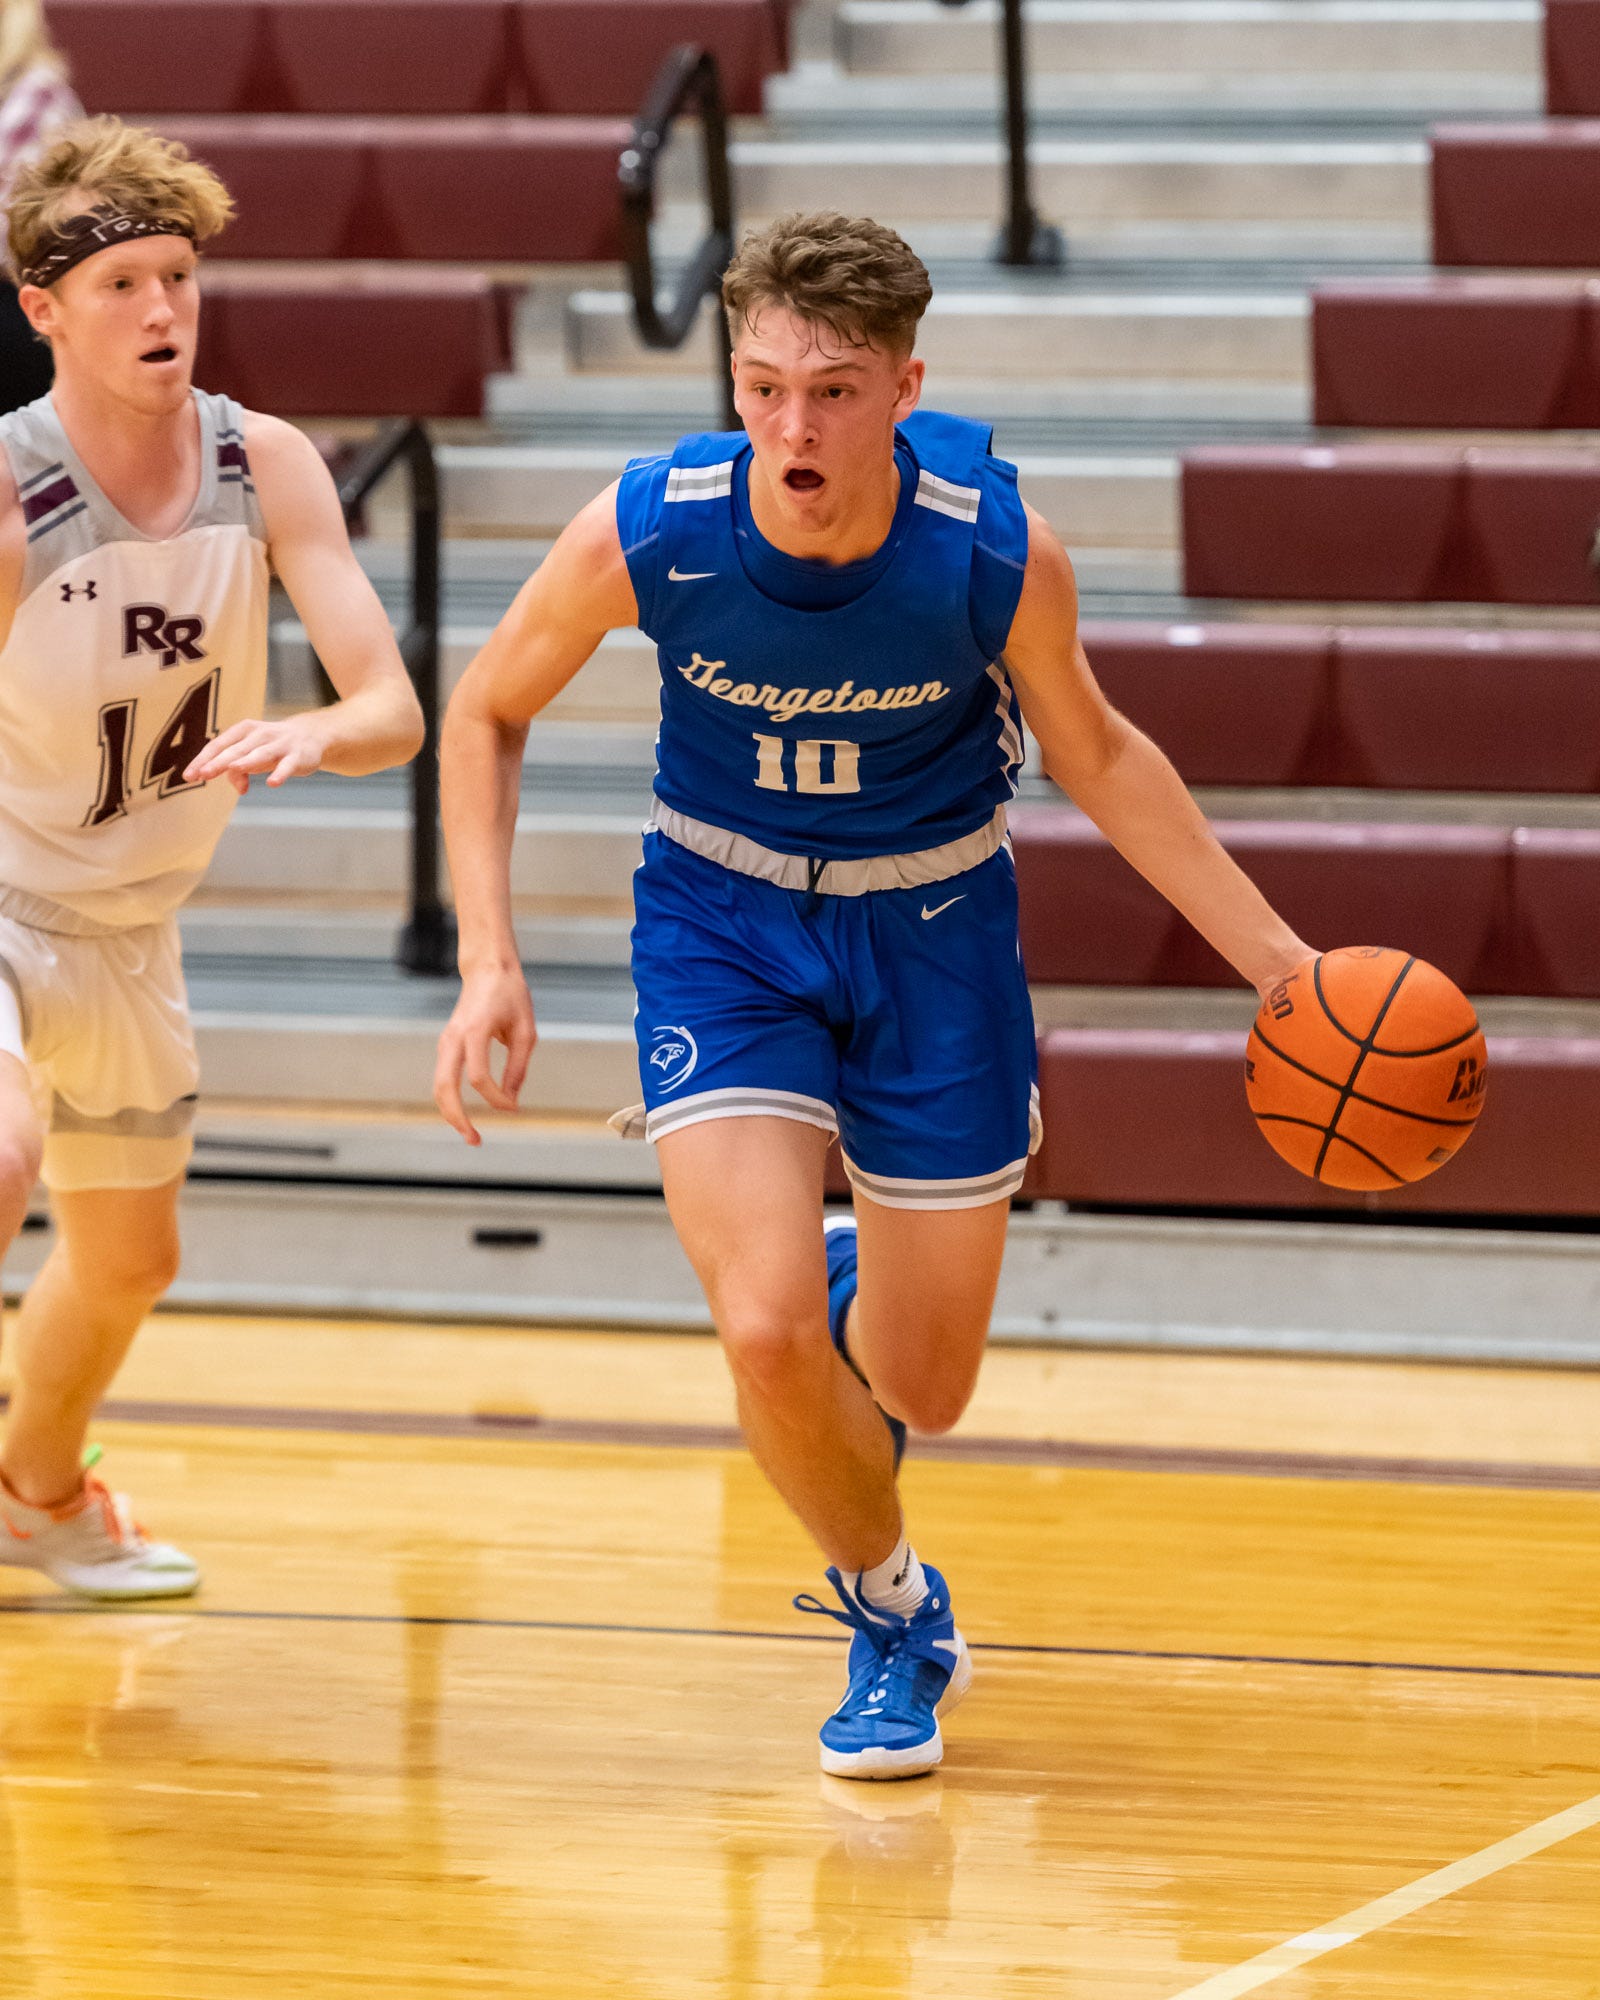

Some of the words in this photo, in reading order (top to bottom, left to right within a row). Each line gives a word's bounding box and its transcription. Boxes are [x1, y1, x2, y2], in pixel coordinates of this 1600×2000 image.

[121, 602, 207, 671] RR
[677, 652, 950, 722] Georgetown
[79, 667, 222, 827] 14
[752, 732, 861, 794] 10
